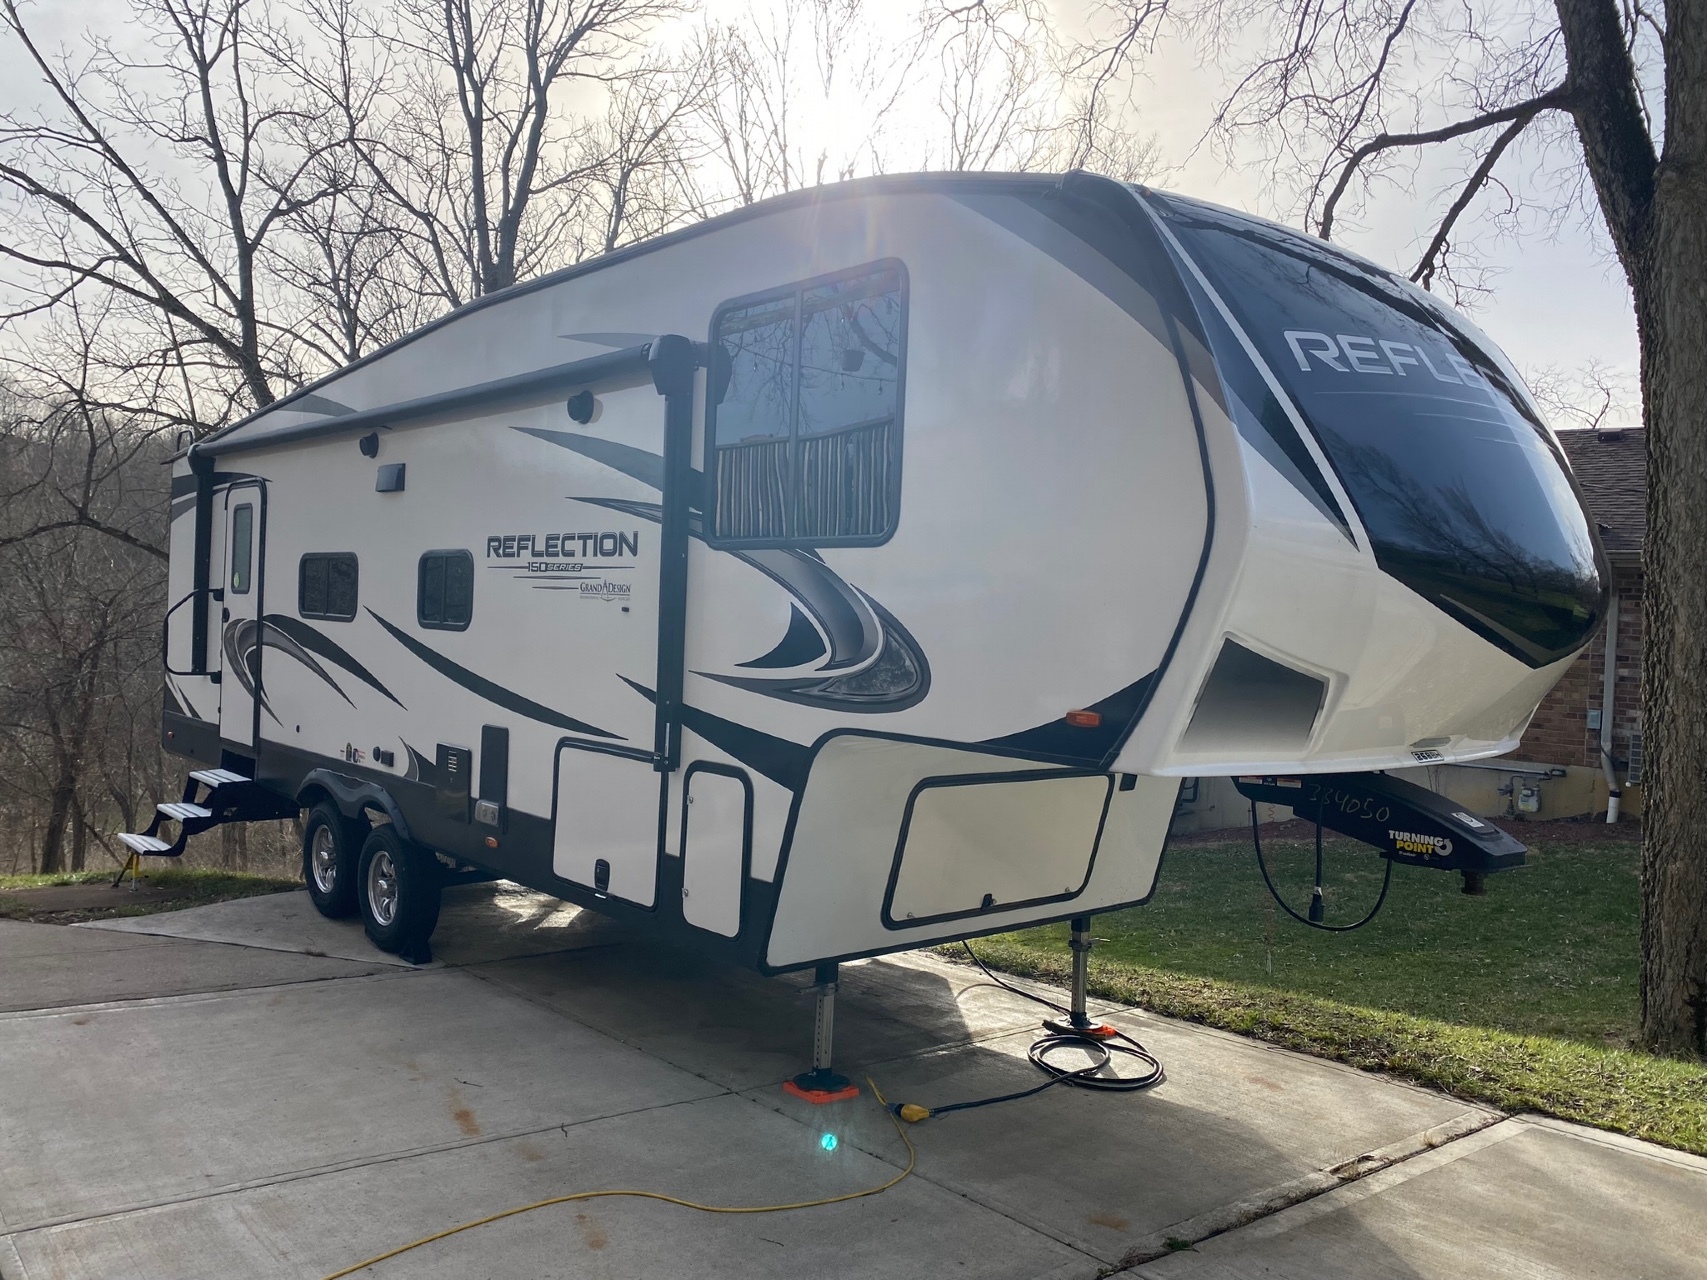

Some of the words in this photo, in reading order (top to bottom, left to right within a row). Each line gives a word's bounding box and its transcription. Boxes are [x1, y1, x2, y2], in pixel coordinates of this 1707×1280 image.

[486, 531, 639, 558] REFLECTION
[527, 561, 548, 573] 150
[547, 562, 583, 572] SERIES
[1388, 829, 1444, 847] TURNING
[1396, 840, 1434, 854] POINT
